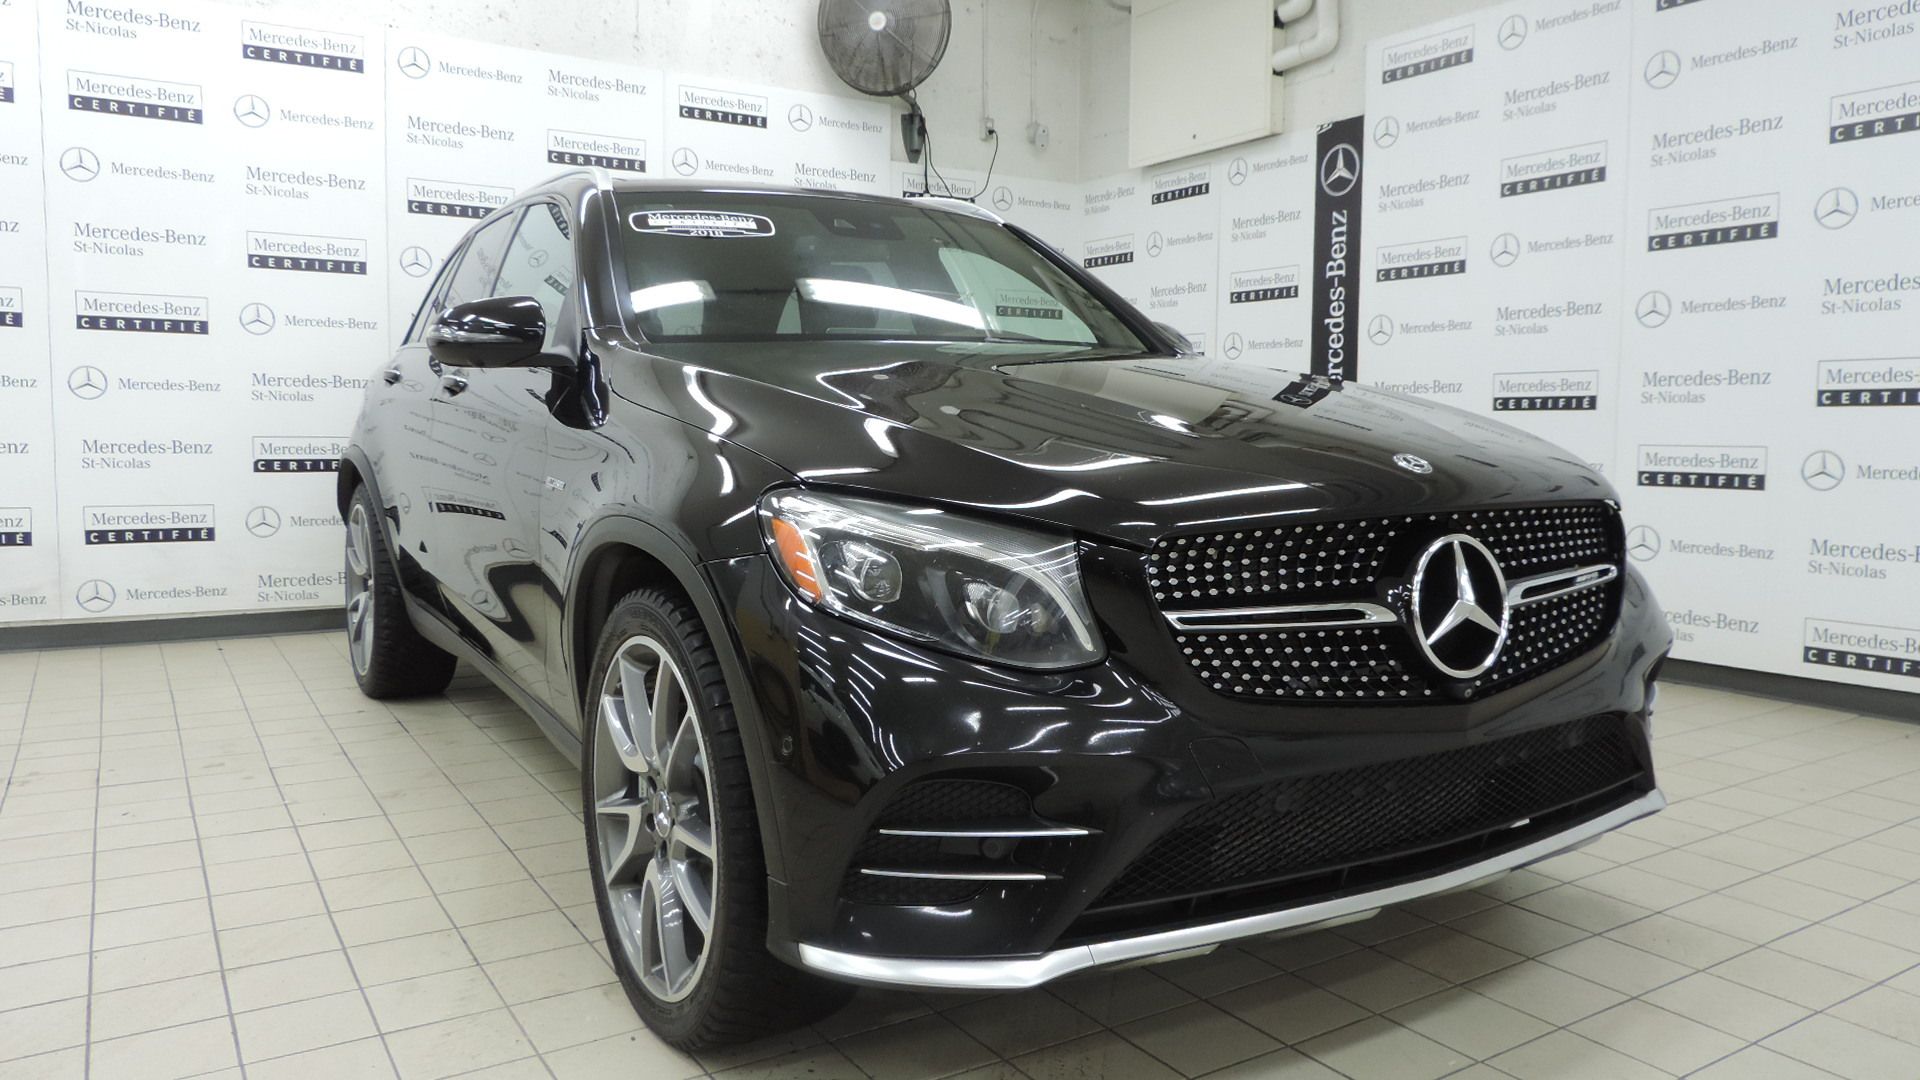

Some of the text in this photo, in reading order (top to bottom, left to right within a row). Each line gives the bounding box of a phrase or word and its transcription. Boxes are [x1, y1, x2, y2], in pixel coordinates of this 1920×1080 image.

[67, 0, 201, 32] Mercedes-Benz
[1535, 0, 1621, 32] Mercedes-Benz
[1835, 0, 1920, 31] Mercede
[66, 19, 137, 39] St-Nicolas
[1833, 21, 1915, 50] St-Nicolas
[249, 28, 356, 54] Mercedes-Benz
[247, 47, 356, 70] CERTIFIÉ
[1386, 35, 1469, 67] Mercedes-Benz
[1690, 36, 1798, 70] Mercedes-Benz
[438, 61, 523, 84] Mercedes-Benz
[1384, 50, 1468, 81] CERTIFIÉ
[76, 77, 194, 104] Mercedes-Benz
[548, 69, 646, 96] Mercedes-Benz
[1504, 71, 1610, 105] Mercedes-Benz
[547, 85, 600, 102] St-Nicolas
[684, 91, 763, 113] Mercedes-Benz
[74, 98, 195, 121] CERTIFIÉ
[682, 108, 763, 127] CERTIFIÉ
[1502, 101, 1557, 122] St-Nicolas
[280, 109, 374, 130] Mercedes-Benz
[407, 116, 515, 142] Mercedes-Benz
[819, 115, 883, 133] Mercedes-Benz
[1406, 109, 1480, 134] Mercedes-Benz
[1834, 116, 1920, 140] CERTI
[406, 134, 464, 150] St-Nicolas
[1651, 115, 1784, 151] Mercedes-Benz
[553, 135, 640, 156] Mercedes-Benz
[551, 153, 642, 170] CERTIFIÉ
[1253, 153, 1308, 173] Mercedes-Benz
[1506, 152, 1601, 178] Mercedes-Benz
[1651, 148, 1717, 168] St-Nicolas
[111, 161, 215, 184] Mercedes-Benz
[705, 160, 774, 177] Mercedes-Benz
[795, 162, 877, 183] Mercedes-Benz
[246, 166, 365, 191] Mercedes-Benz
[1155, 170, 1206, 190] Mercedes-Benz
[1379, 174, 1470, 199] Mercedes-Benz
[1503, 170, 1600, 196] CERTIFIÉ
[246, 183, 310, 200] St-Nicolas
[1153, 183, 1208, 204] CERTIFIÉ
[411, 202, 487, 218] CERTIF
[1018, 197, 1071, 211] Mercedes-Benz
[1378, 197, 1424, 213] St-Nicolas
[1232, 210, 1301, 230] Mercedes-Benz
[1655, 205, 1770, 231] Mercedes-Benz
[74, 222, 206, 246] Mercedes-Benz
[1167, 232, 1213, 247] Mercedes-Benz
[1231, 230, 1266, 243] St-Nicolas
[1527, 234, 1614, 253] Mercedes-Benz
[1652, 224, 1769, 249] CERTIFIÉ
[74, 241, 143, 257] St-Nicolas
[254, 238, 360, 257] Mercedes-Benz
[1381, 245, 1461, 265] Mercedes-Benz
[252, 257, 361, 273] CERTIFIÉ
[1084, 252, 1133, 268] CERTIFIÉ
[1233, 273, 1295, 288] Mercedes-Benz
[1379, 261, 1461, 281] CERTIFIÉ
[1150, 282, 1208, 298] Mercedes-Benz
[1823, 273, 1920, 296] Mercedes
[1232, 287, 1296, 302] CERTIFIÉ
[83, 297, 200, 316] Mercedes-Benz
[1496, 301, 1602, 322] Mercedes-Benz
[1681, 295, 1786, 314] Mercedes-Benz
[1821, 299, 1901, 315] St-Nicolas
[81, 317, 200, 333] CERTIFIÉ
[285, 315, 377, 330] Mercedes-Benz
[1400, 320, 1472, 334] Mercedes-Benz
[1495, 323, 1548, 337] St-Nicolas
[1249, 339, 1303, 350] Mercedes-Benz
[119, 377, 221, 392] Mercedes-Benz
[252, 373, 369, 389] Mercedes-Benz
[1642, 369, 1771, 387] Mercedes-Benz
[1826, 367, 1920, 384] Mercedes-
[1499, 379, 1592, 393] Mercedes-Benz
[252, 390, 314, 402] St-Nicolas
[1495, 396, 1590, 409] CERTIFIÉ
[1640, 391, 1705, 404] St-Nicolas
[1822, 391, 1920, 405] CERTI
[82, 439, 213, 454] Mercedes-Benz
[260, 443, 348, 455] Mercedes-Be
[82, 457, 150, 469] St-Nicolas
[257, 460, 340, 470] CERTIF
[1645, 452, 1758, 469] Mercedes-Benz
[1641, 473, 1757, 488] CERTIFIÉ
[92, 511, 207, 526] Mercedes-Benz
[290, 516, 344, 527] Mercede
[90, 528, 209, 543] CERTIFIÉ
[1670, 539, 1774, 560] Mercedes-Benz
[1808, 560, 1887, 579] St-Nicolas
[258, 571, 347, 588] Mercedes-B
[126, 586, 227, 601] Mercedes-Benz
[257, 590, 319, 602] St-Nicolas
[1664, 610, 1759, 634] cedes-Benz
[1807, 649, 1920, 675] CERTIF
